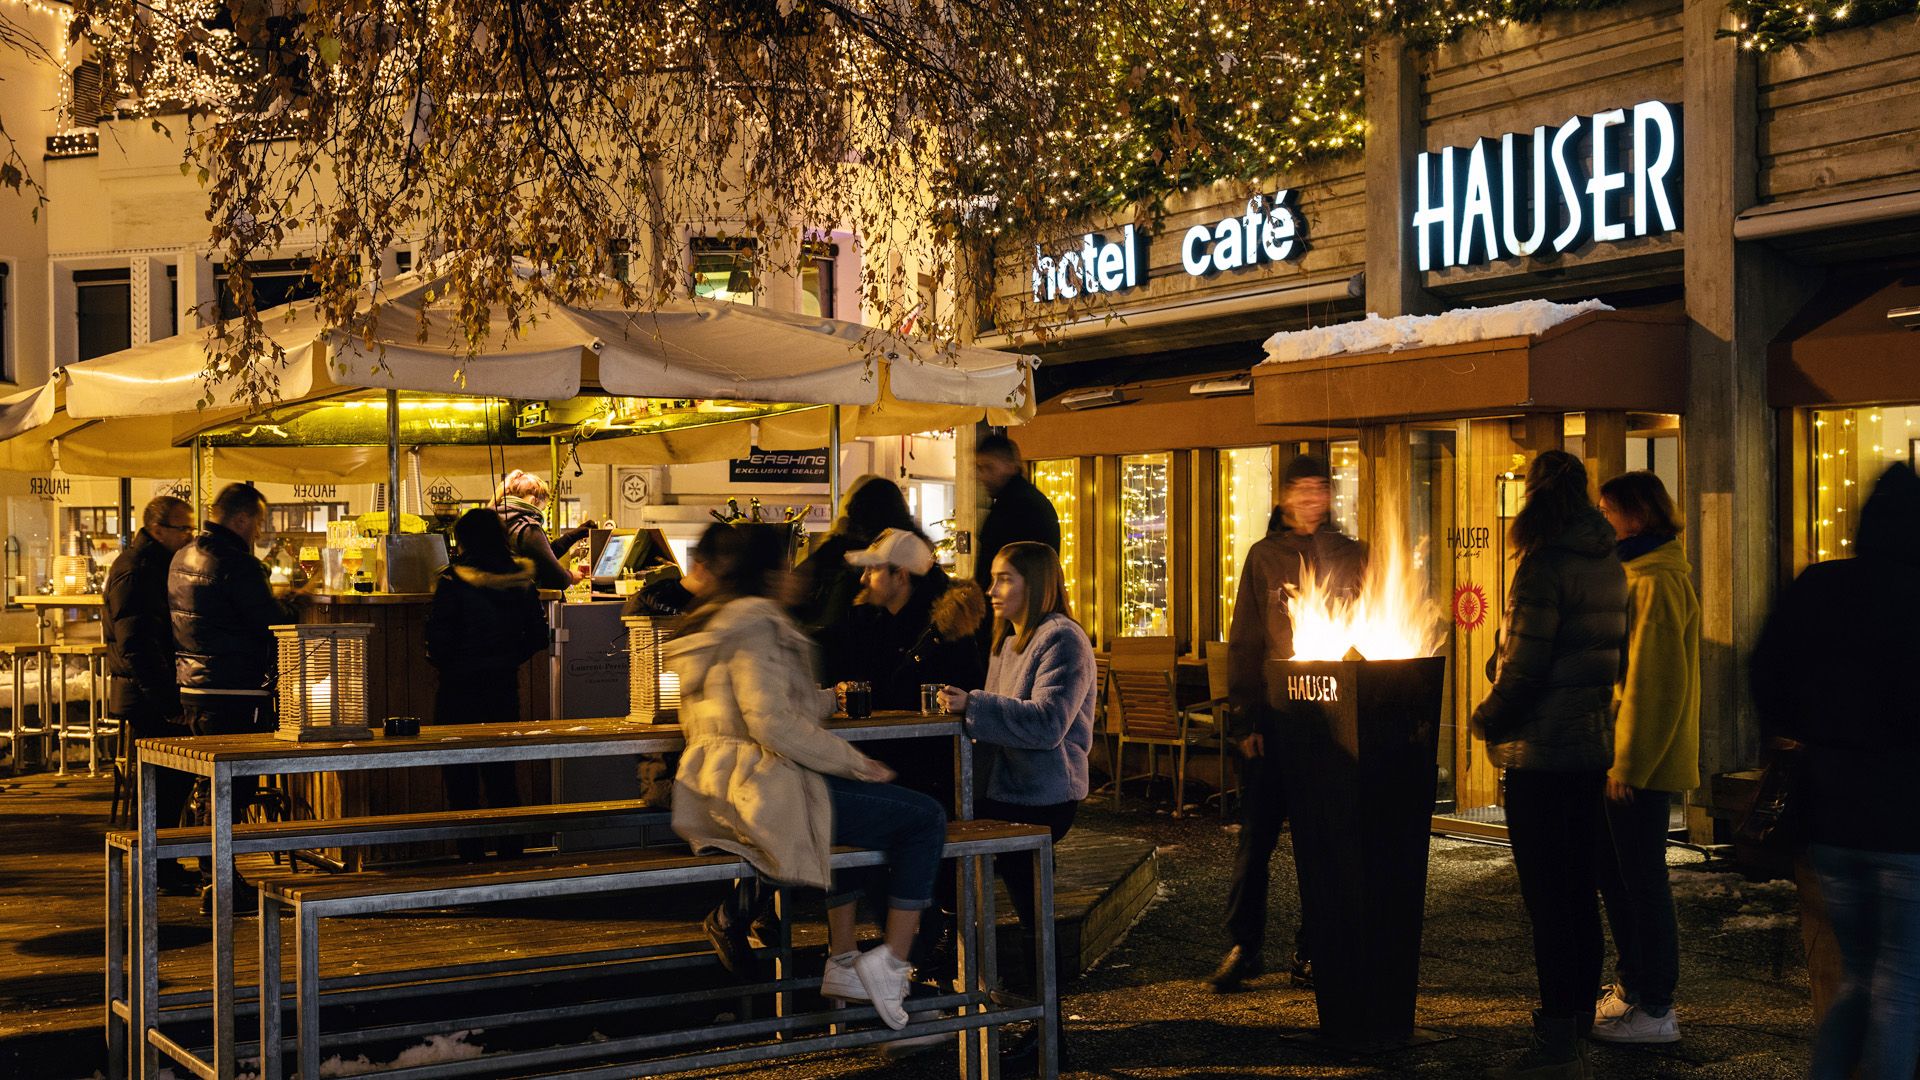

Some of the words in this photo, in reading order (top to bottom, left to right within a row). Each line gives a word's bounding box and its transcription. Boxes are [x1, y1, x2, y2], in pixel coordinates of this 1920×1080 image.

[1412, 100, 1677, 272] HAUSER
[1032, 223, 1137, 303] hotel
[1182, 189, 1296, 276] café
[735, 467, 789, 475] EXCLUSIVE
[791, 467, 826, 475] DEALER
[1446, 527, 1490, 549] HAUSER
[1287, 675, 1338, 702] HAUSER
